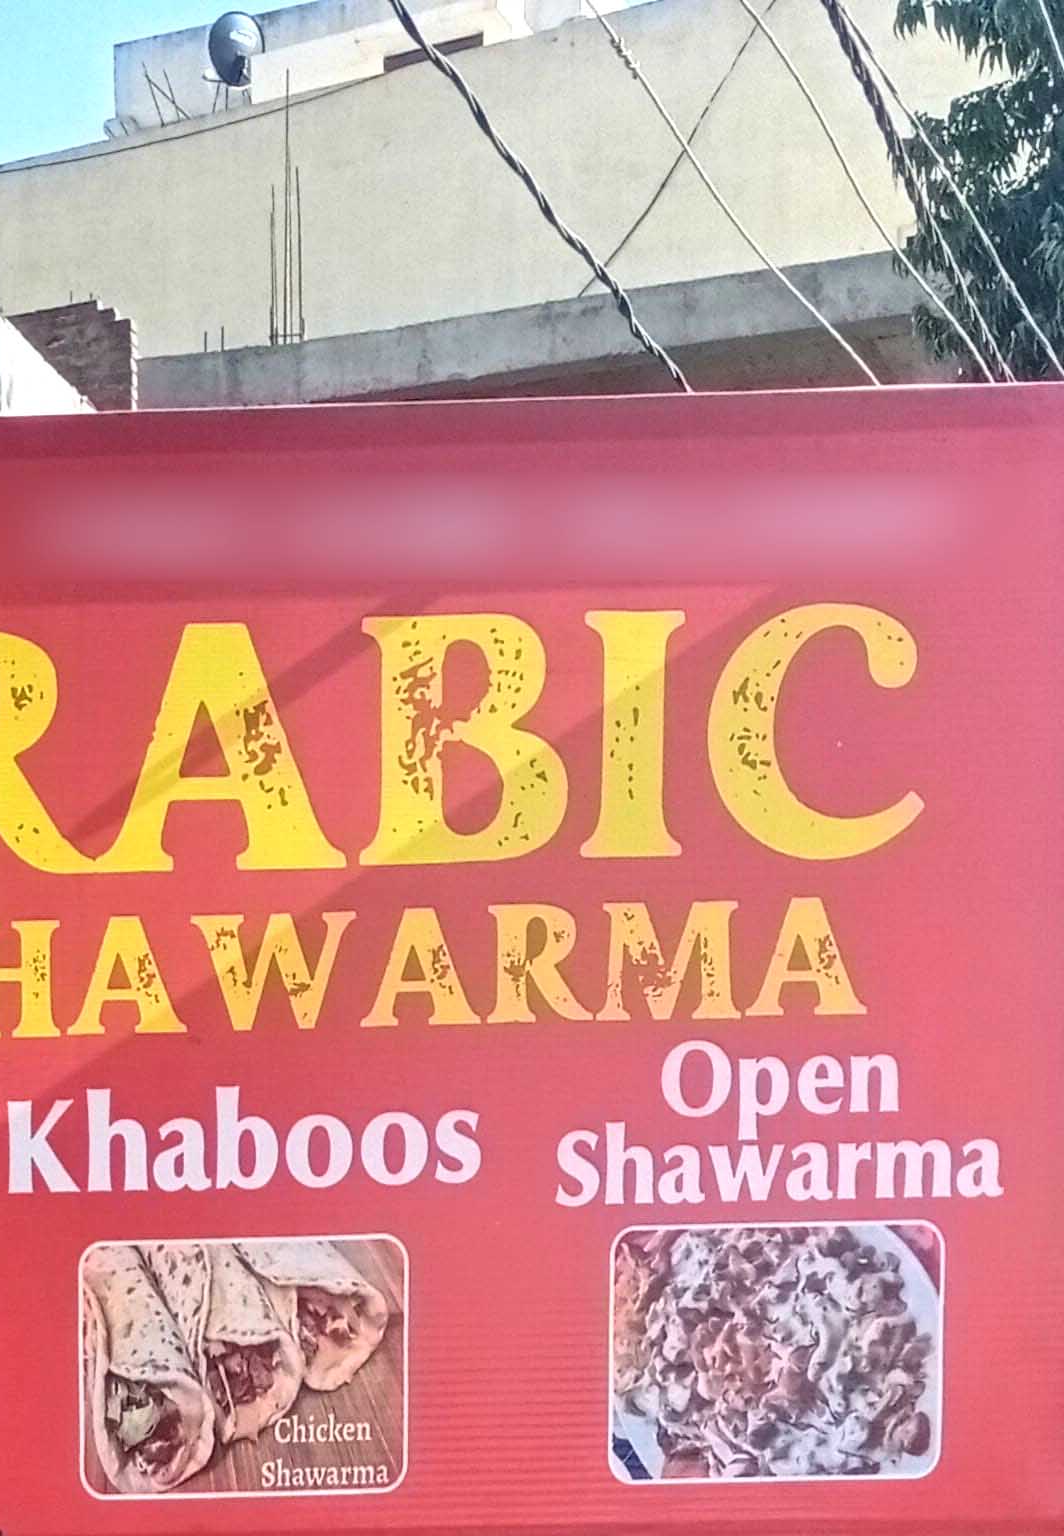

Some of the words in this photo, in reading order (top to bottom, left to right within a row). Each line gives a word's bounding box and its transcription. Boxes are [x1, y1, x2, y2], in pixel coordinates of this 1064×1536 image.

[660, 1040, 900, 1141] Open
[6, 1085, 483, 1194] Khaboos
[555, 1121, 1005, 1208] Shawarma
[274, 1413, 372, 1444] Chicken
[261, 1457, 389, 1488] Shawarma
